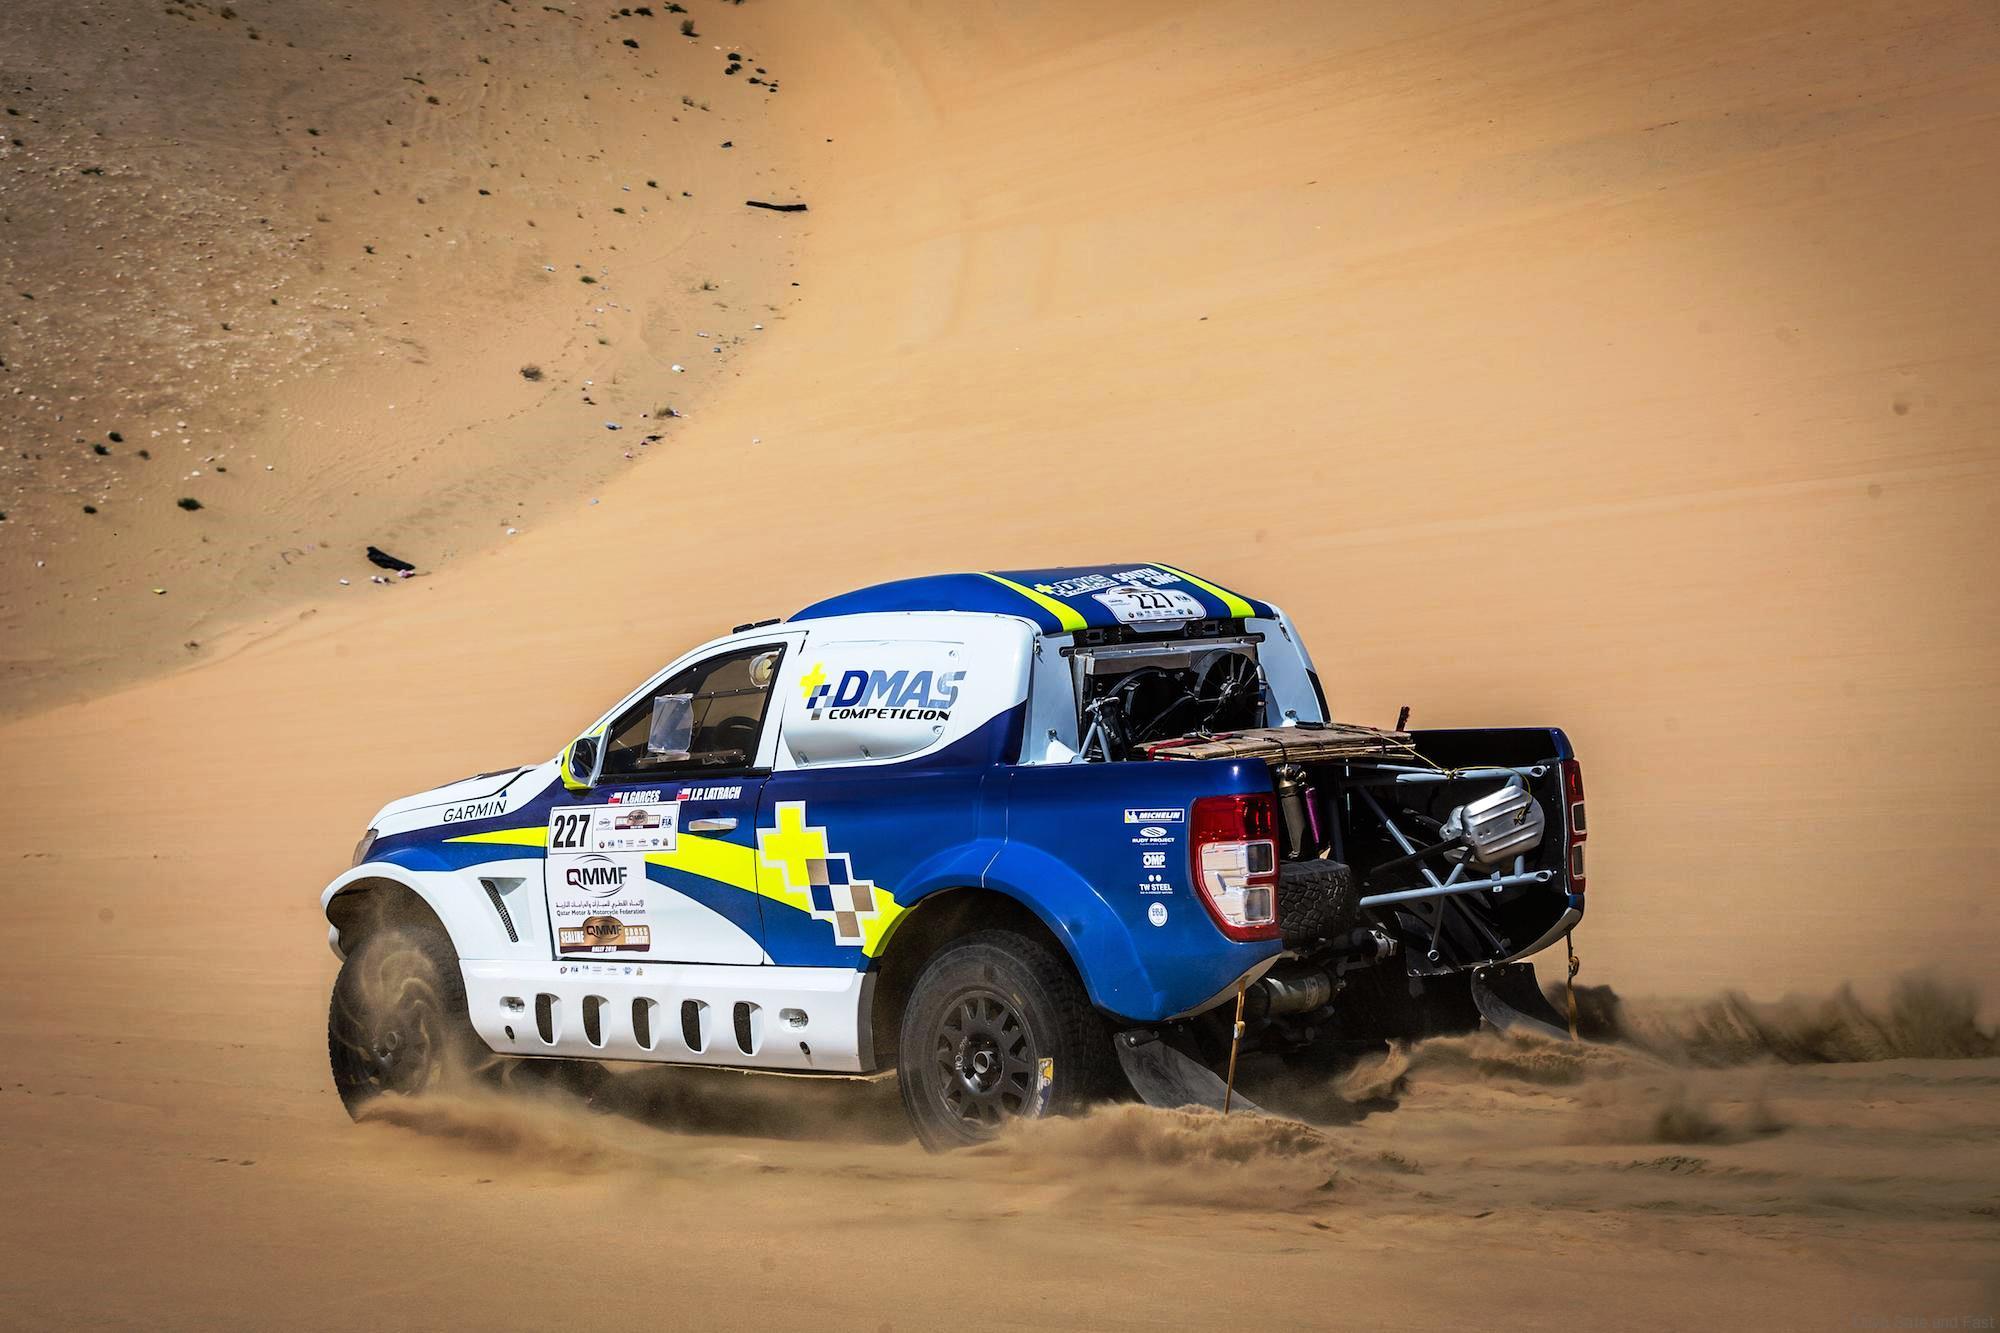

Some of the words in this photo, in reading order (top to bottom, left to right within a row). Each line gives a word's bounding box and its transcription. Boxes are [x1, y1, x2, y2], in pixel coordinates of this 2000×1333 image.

[1127, 592, 1174, 609] 227
[831, 670, 967, 709] DMAS
[828, 708, 952, 721] COMPETICION
[622, 789, 661, 804] H.GARCES
[703, 786, 742, 800] LATRACH
[443, 799, 507, 822] GARMIN
[1139, 811, 1181, 819] MICHELIN
[553, 814, 590, 848] 227
[1143, 854, 1166, 866] OMP
[566, 866, 628, 886] QMMF
[1139, 883, 1150, 891] TW
[1151, 883, 1173, 891] STEEL
[556, 909, 570, 917] Qatar
[592, 909, 619, 917] Motorcycle
[619, 908, 646, 916] Federation
[586, 924, 621, 936] QMMF
